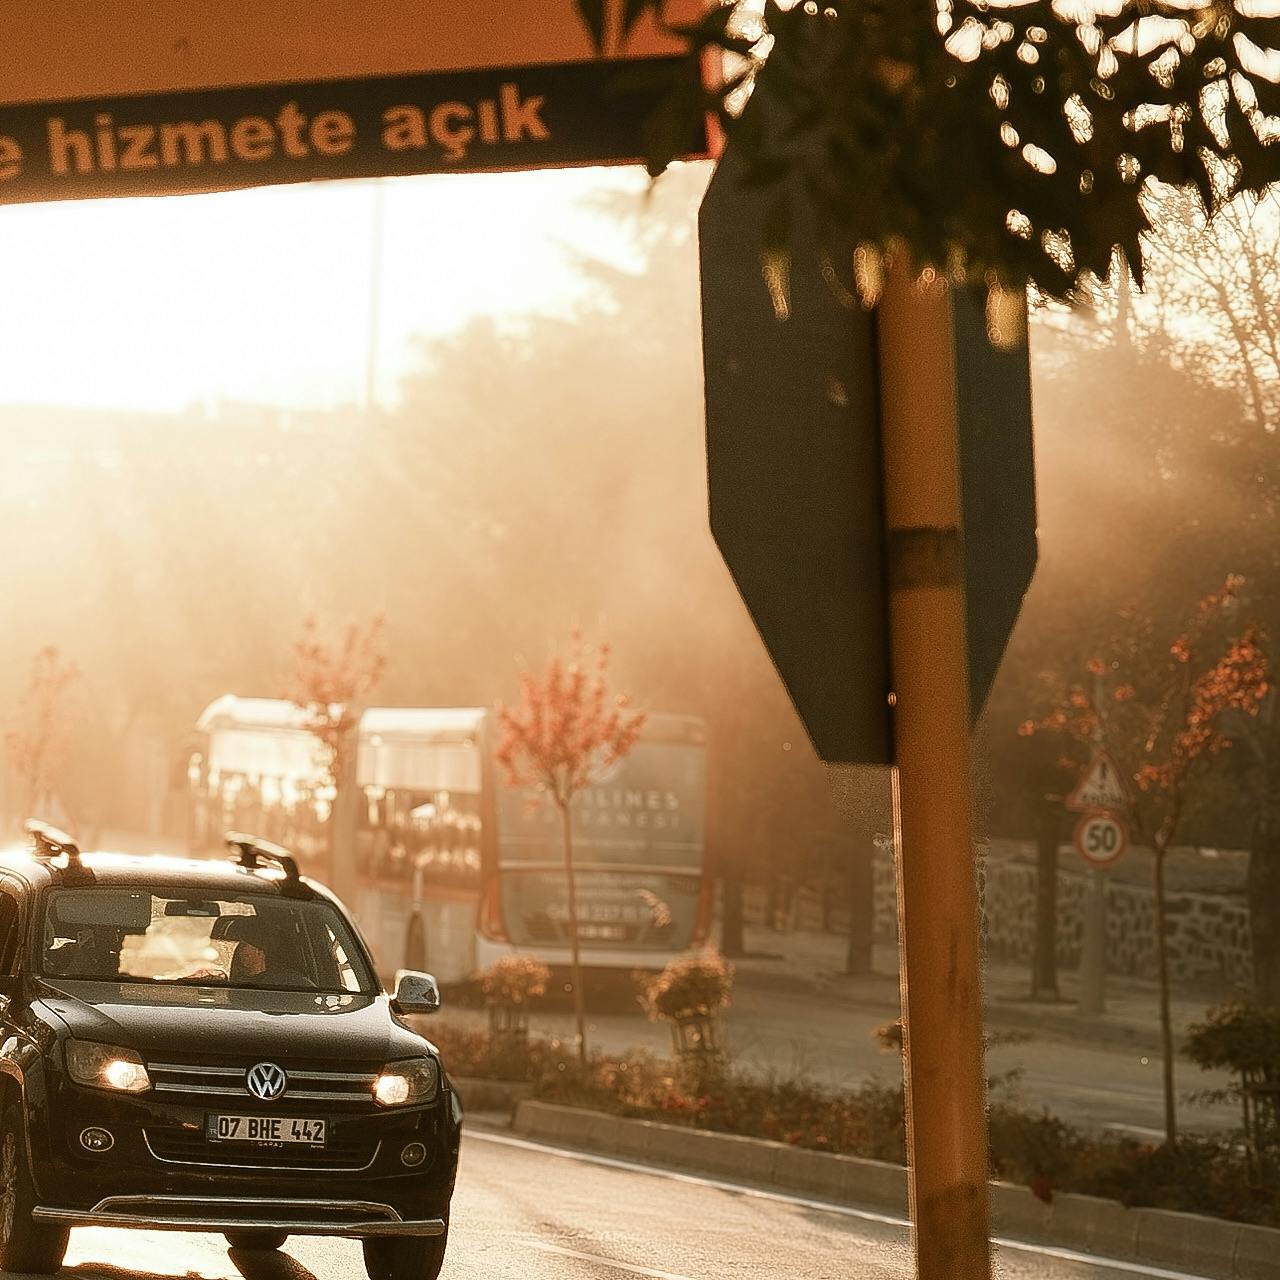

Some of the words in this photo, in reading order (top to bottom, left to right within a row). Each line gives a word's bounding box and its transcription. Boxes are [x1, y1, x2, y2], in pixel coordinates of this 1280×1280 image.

[47, 99, 355, 176] hizmete
[382, 83, 551, 161] açık
[1088, 824, 1117, 852] 50
[219, 1117, 241, 1138] 07
[248, 1118, 282, 1140] BHE
[290, 1120, 324, 1142] 442
